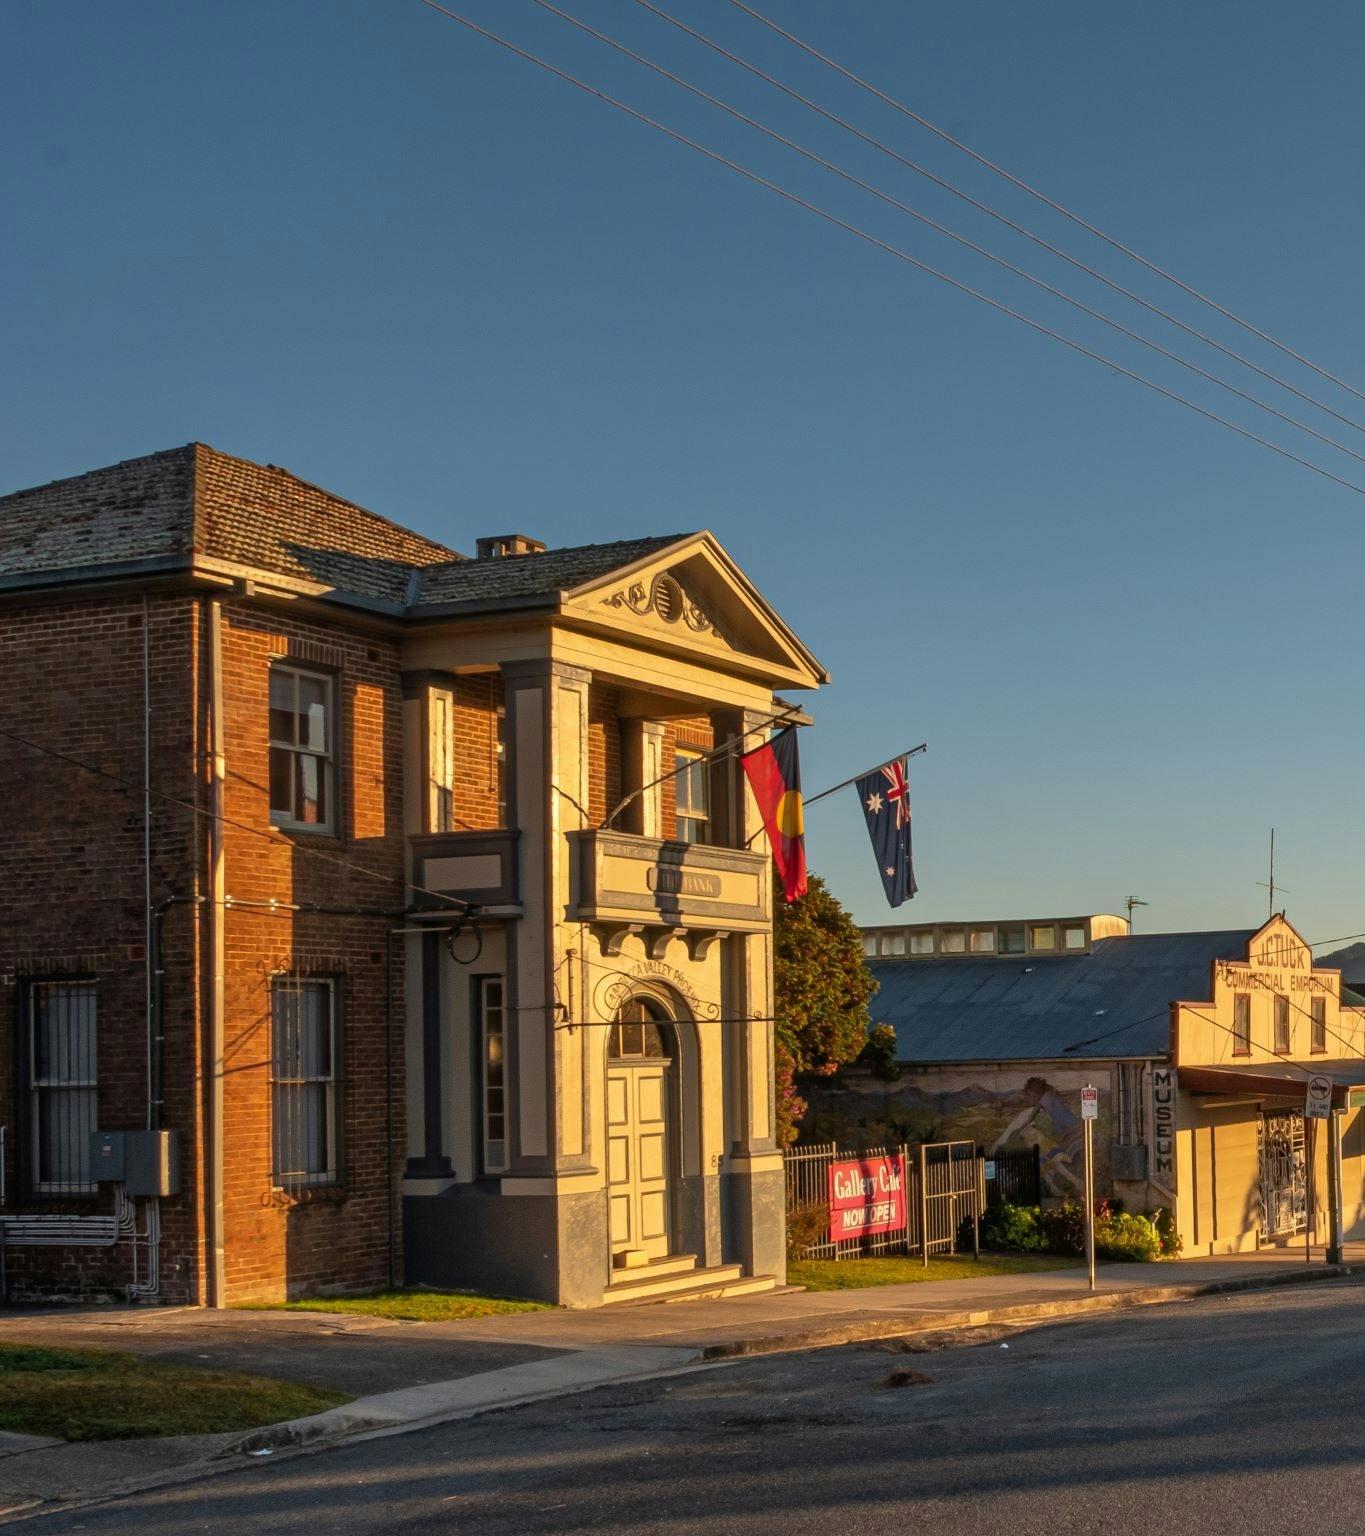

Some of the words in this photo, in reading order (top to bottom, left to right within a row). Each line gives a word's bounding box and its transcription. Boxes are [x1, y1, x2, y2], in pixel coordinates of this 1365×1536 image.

[684, 876, 713, 893] BANK
[643, 960, 673, 976] VALLEY
[672, 968, 701, 1011] PHOENIX
[1226, 971, 1285, 991] COMMERCIAL
[1290, 975, 1334, 992] EMPORIUM
[1155, 1071, 1173, 1173] MUSEUM
[834, 1168, 878, 1200] Gallery
[842, 1207, 869, 1227] NOW
[869, 1203, 896, 1223] OPEN
